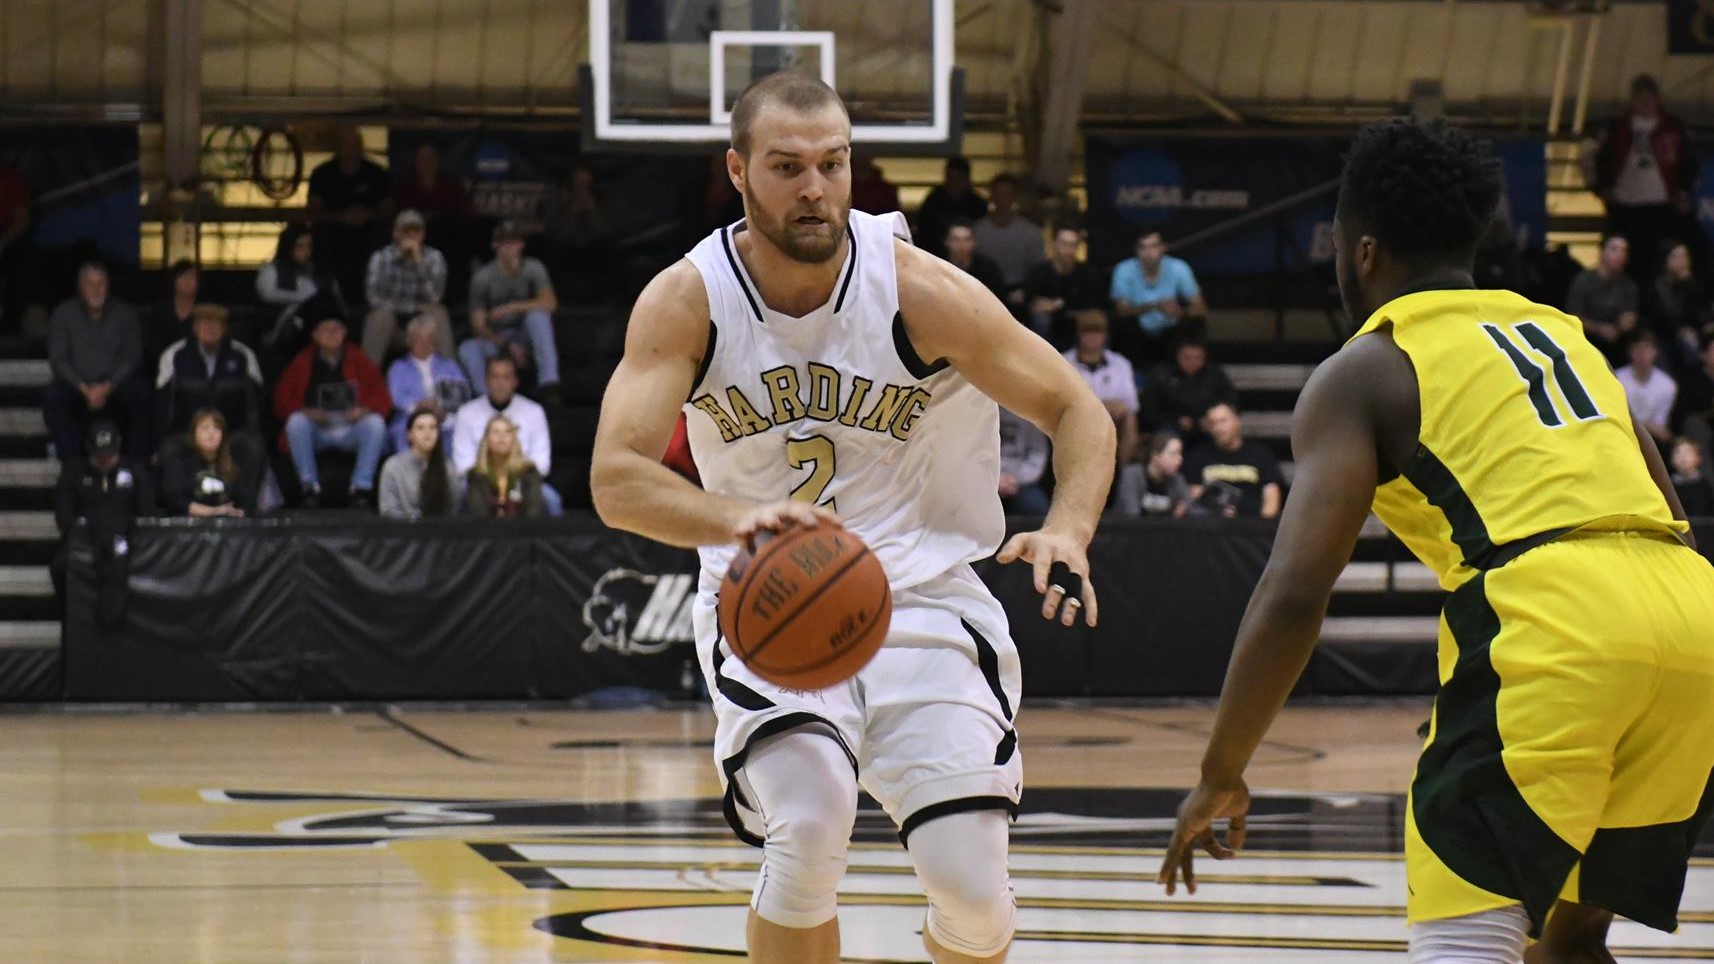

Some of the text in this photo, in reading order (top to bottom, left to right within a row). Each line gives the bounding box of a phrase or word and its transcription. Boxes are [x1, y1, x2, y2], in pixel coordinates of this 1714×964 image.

[691, 361, 932, 443] HARDING
[1480, 320, 1606, 428] 11
[786, 433, 837, 514] 2
